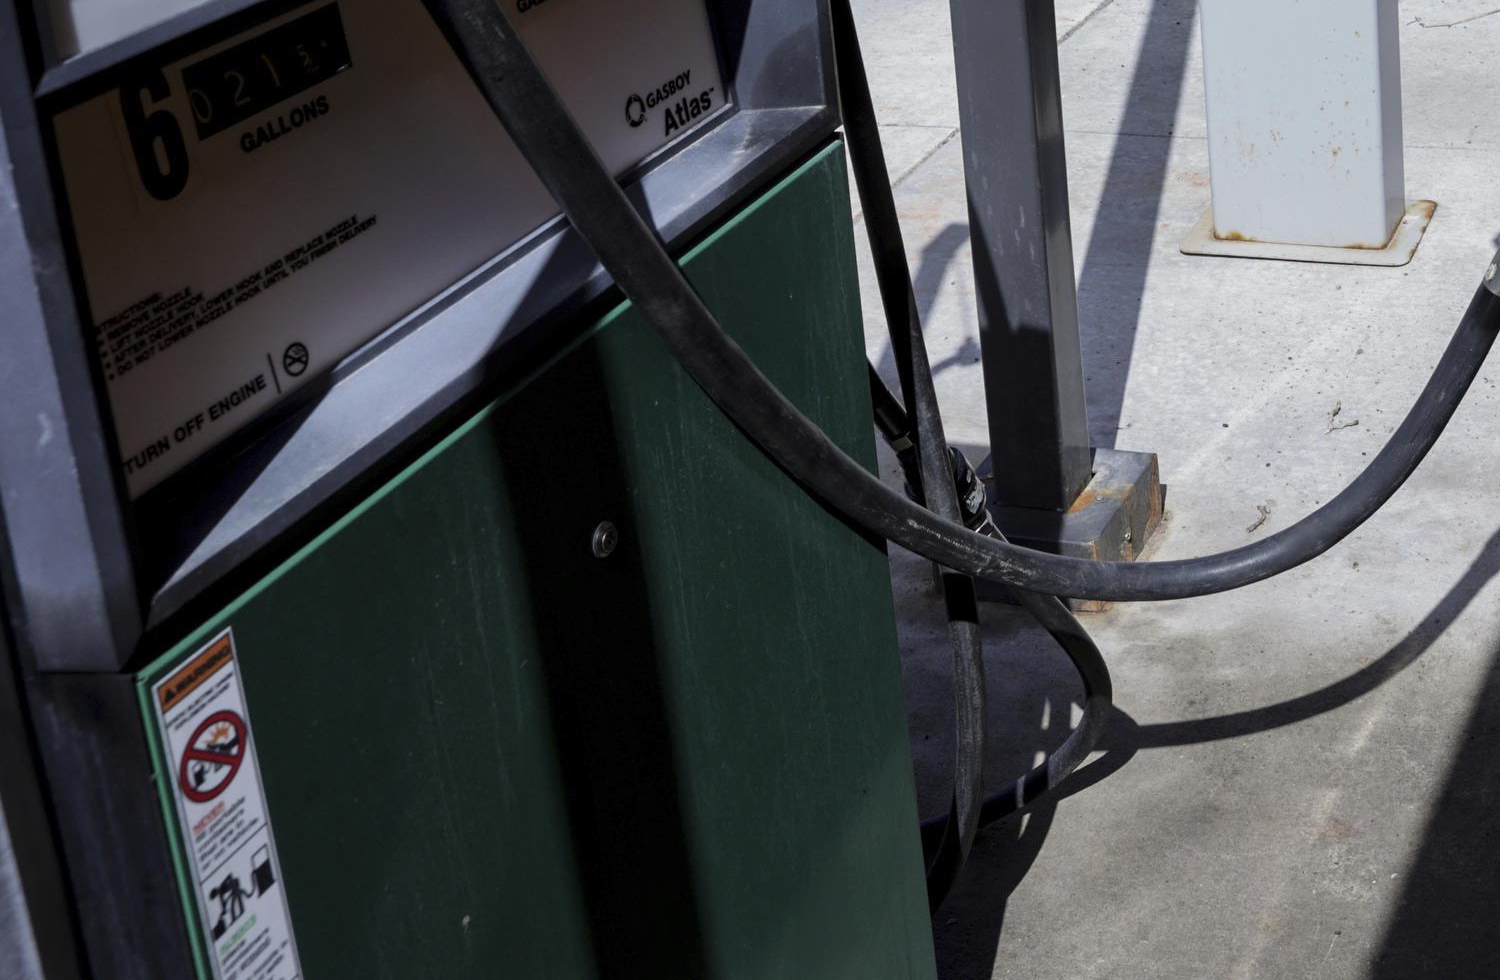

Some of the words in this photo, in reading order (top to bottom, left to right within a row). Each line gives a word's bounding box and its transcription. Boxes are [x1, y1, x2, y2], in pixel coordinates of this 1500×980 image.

[240, 96, 329, 152] GALLONS
[646, 69, 690, 108] GASBOY
[119, 68, 189, 201] 6
[107, 311, 149, 340] REMOVE
[153, 287, 191, 313] NOZZLE
[110, 333, 132, 353] LIFT
[135, 311, 173, 338] NOZZLE
[177, 292, 205, 312] HOOK
[115, 339, 146, 363] AFTER
[200, 287, 233, 314] LOWER
[236, 271, 262, 293] HOOK
[264, 259, 284, 275] AND
[285, 235, 324, 263] REPLACE
[325, 214, 358, 240] NOZZLE
[117, 360, 133, 375] DO
[135, 345, 156, 364] NOT
[159, 324, 194, 351] LOWER
[196, 300, 233, 329] NOZZLE
[235, 284, 261, 306] HOOK
[263, 269, 290, 289] UNTIL
[290, 256, 309, 273] YOU
[311, 239, 339, 262] FINISH
[339, 214, 377, 245] DELIVERY
[123, 436, 171, 473] TURN
[174, 413, 205, 442] OFF
[208, 374, 267, 421] ENGINE
